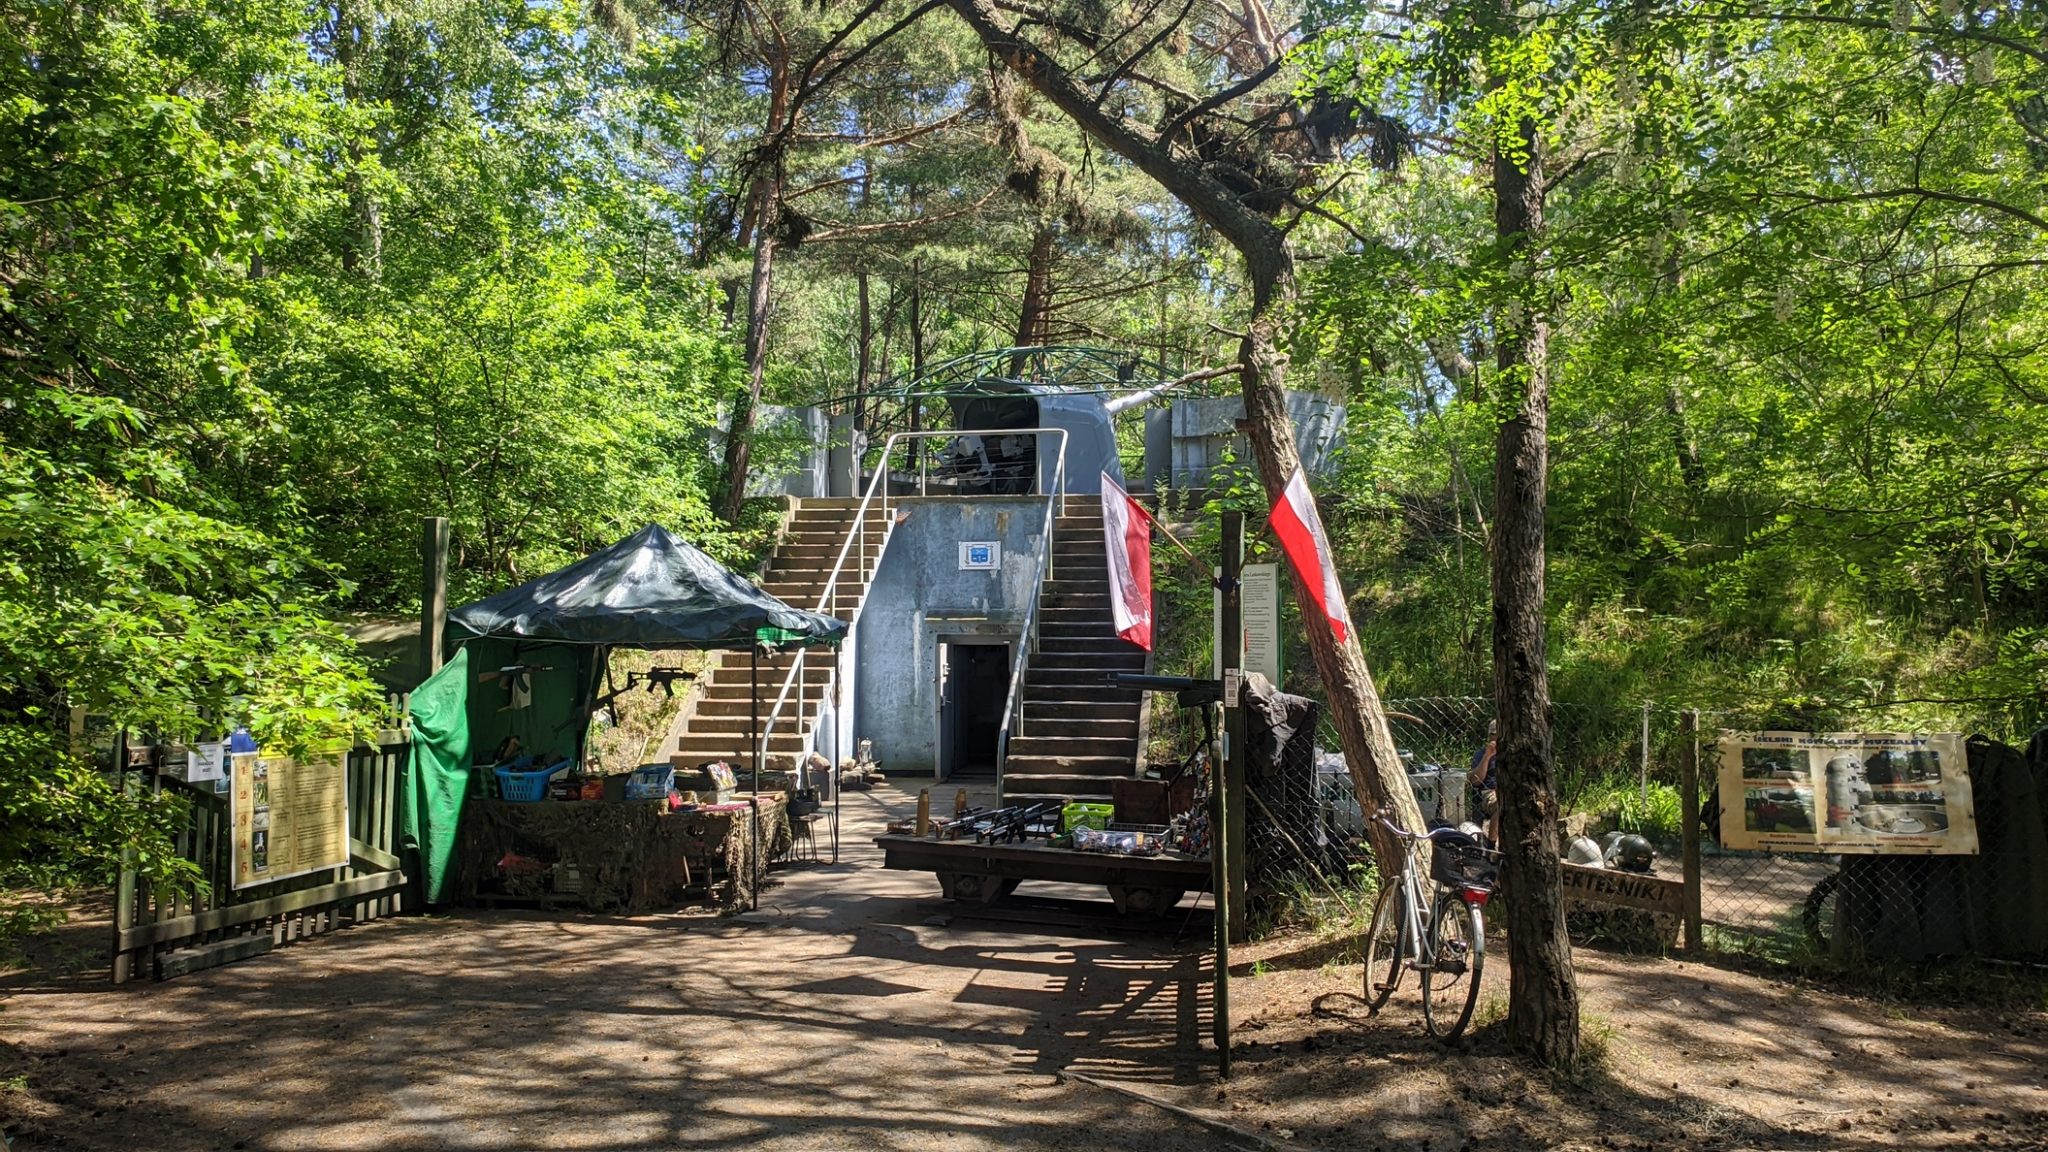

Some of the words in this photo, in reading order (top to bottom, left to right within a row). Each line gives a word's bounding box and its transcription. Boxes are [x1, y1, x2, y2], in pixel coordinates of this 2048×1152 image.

[1799, 737, 1859, 745] KOMEKS
[240, 790, 248, 800] 2
[240, 814, 247, 826] 3
[240, 838, 247, 850] 4
[240, 861, 248, 873] 5
